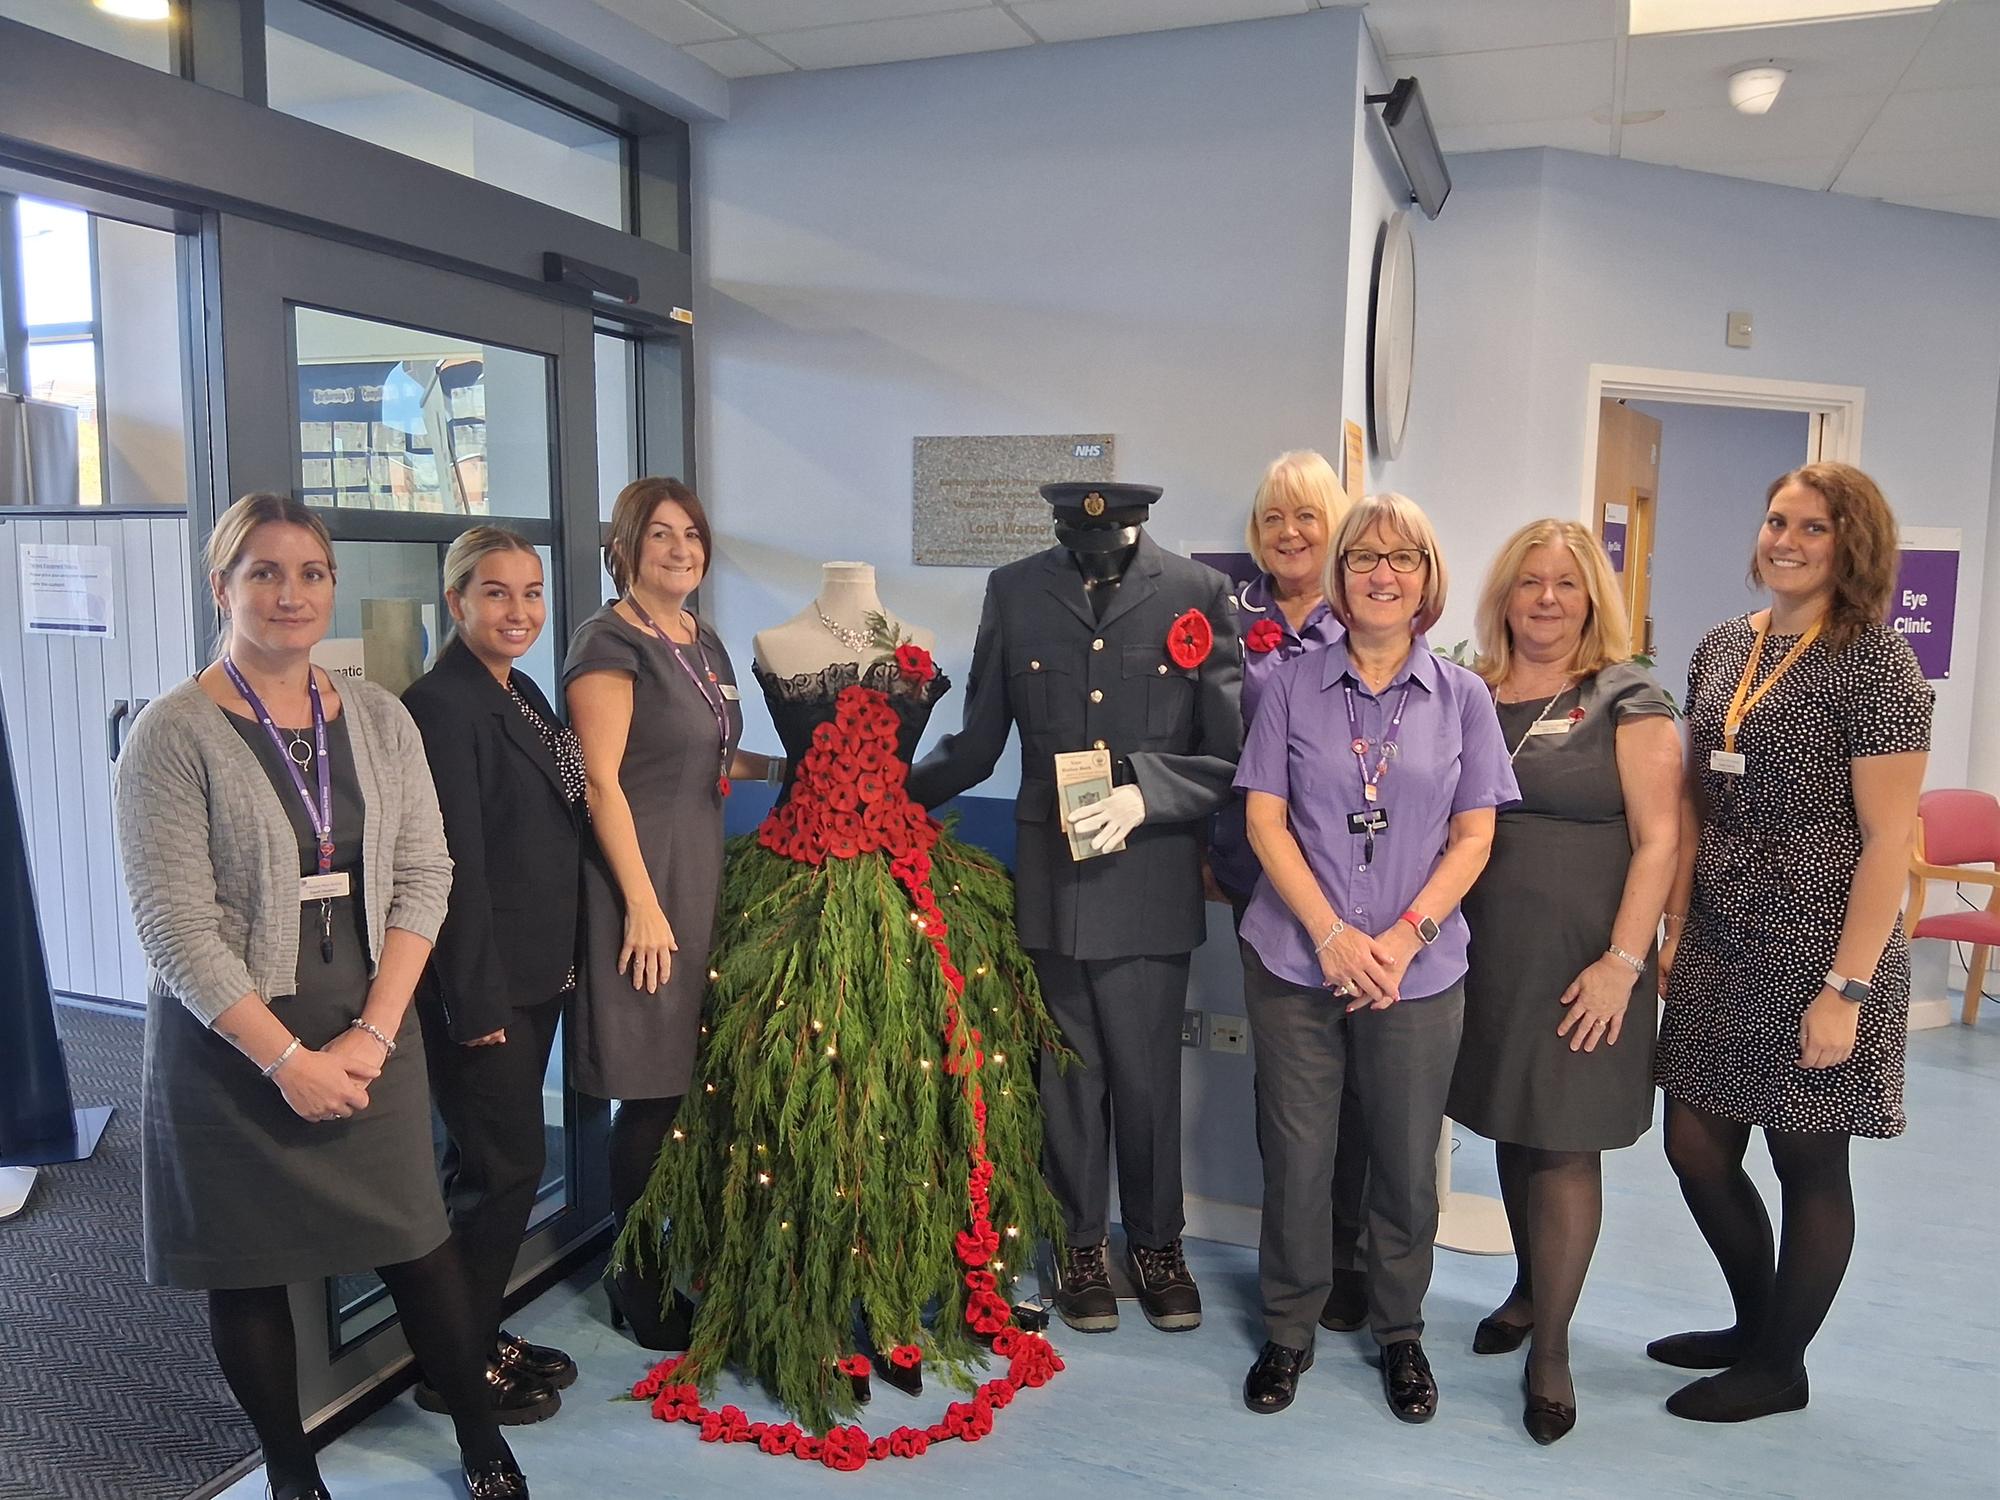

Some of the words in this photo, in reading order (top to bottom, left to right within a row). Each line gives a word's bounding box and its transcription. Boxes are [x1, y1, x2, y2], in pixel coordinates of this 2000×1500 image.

[1075, 445, 1101, 457] NHS
[968, 521, 998, 534] Lord
[1902, 590, 1928, 610] Eye
[1894, 617, 1933, 634] Clinic
